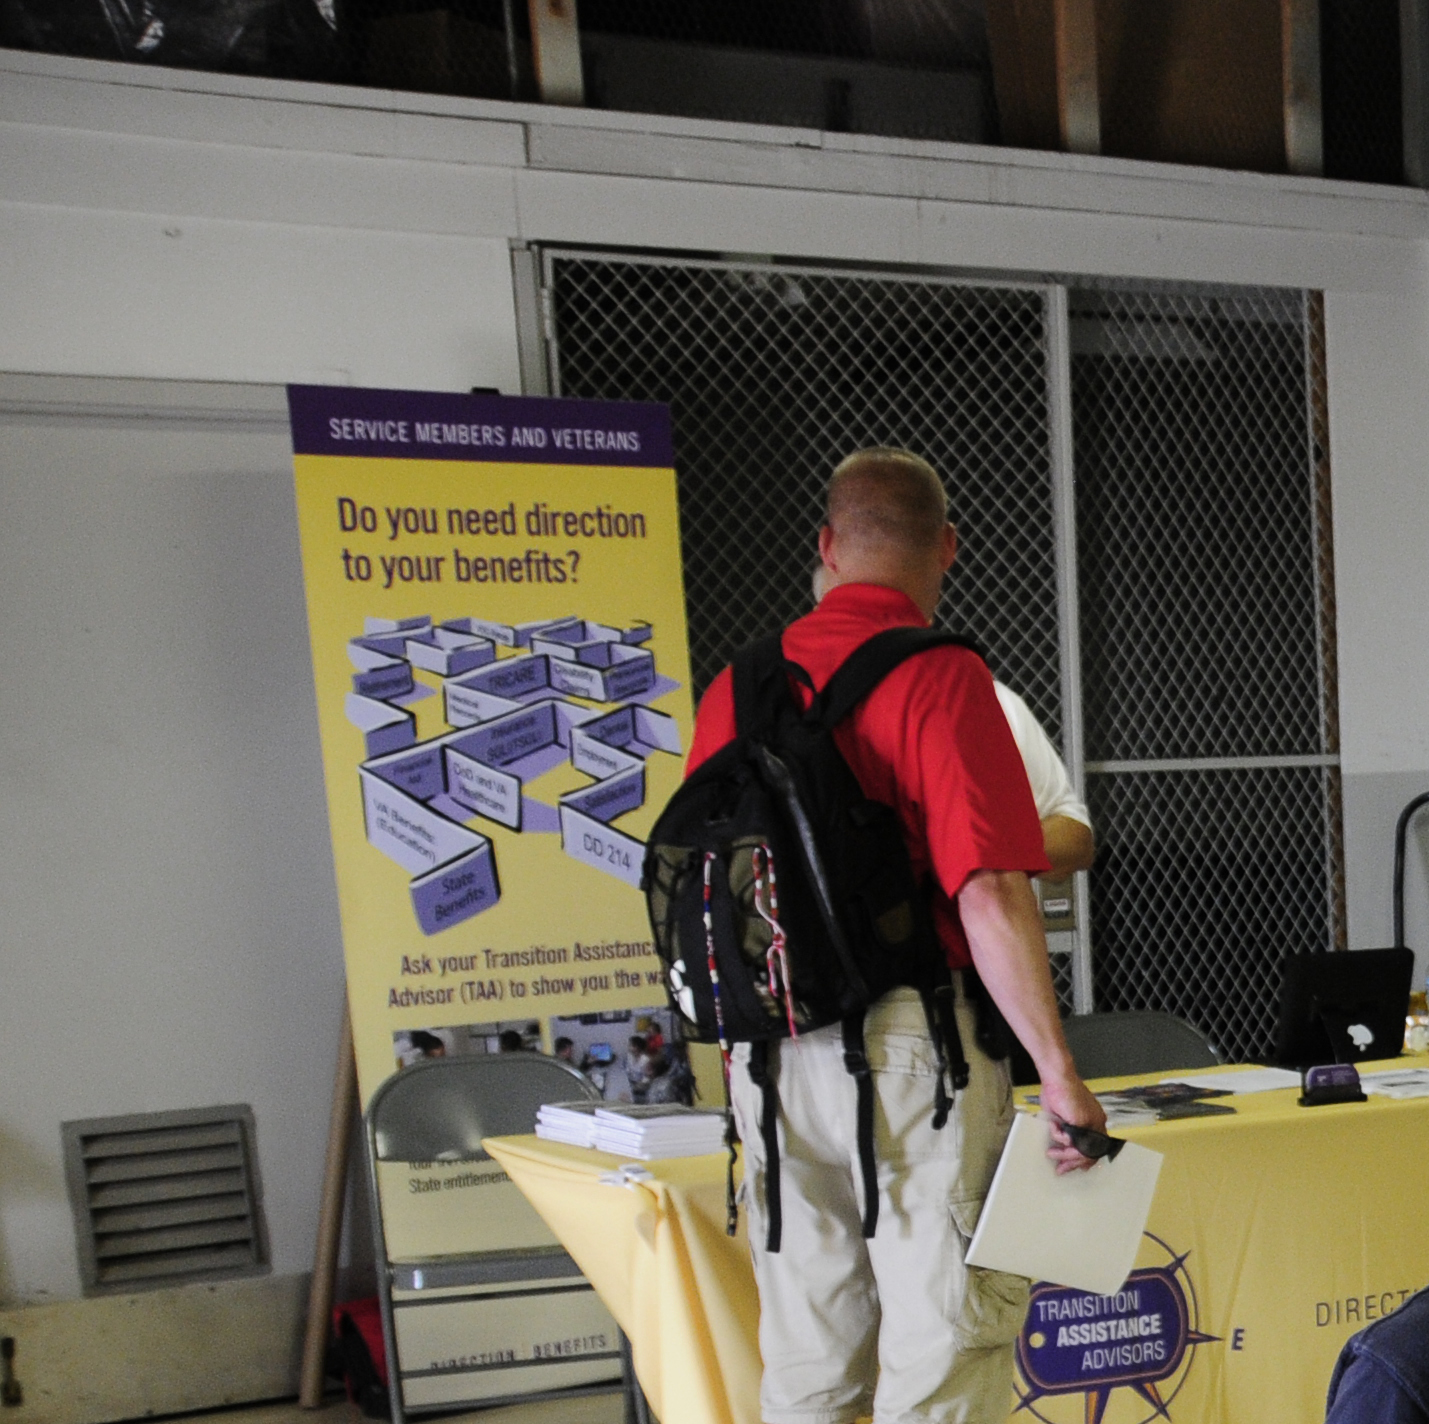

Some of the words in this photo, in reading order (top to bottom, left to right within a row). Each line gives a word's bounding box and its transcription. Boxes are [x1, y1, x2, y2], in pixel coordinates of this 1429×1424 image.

[329, 418, 408, 443] SERVICE
[415, 423, 506, 447] MEMBERS
[512, 427, 547, 448] AND
[553, 429, 641, 452] VETERANS
[337, 497, 377, 533] Do
[385, 505, 438, 541] you
[448, 503, 517, 537] need
[526, 503, 646, 538] direction
[342, 549, 371, 581] to
[380, 554, 445, 589] your
[455, 549, 580, 583] benefits?
[607, 844, 631, 870] 214
[442, 873, 474, 894] State
[434, 887, 485, 922] Benefits
[401, 954, 432, 976] Ask
[438, 952, 478, 977] your
[484, 945, 568, 969] Transition
[388, 987, 454, 1008] Advisor
[459, 980, 503, 1005] (TAA)
[509, 980, 526, 998] to
[532, 975, 575, 997] show
[579, 971, 609, 996] you
[613, 968, 640, 988] the
[409, 1177, 441, 1195] State
[1036, 1290, 1139, 1321] TRANSITION
[1315, 1289, 1417, 1327] DIRECT
[533, 1334, 606, 1358] BENEFITS
[1057, 1313, 1162, 1347] ASSISTANCE
[1232, 1328, 1245, 1351] E
[1081, 1340, 1166, 1371] ADVISORS
